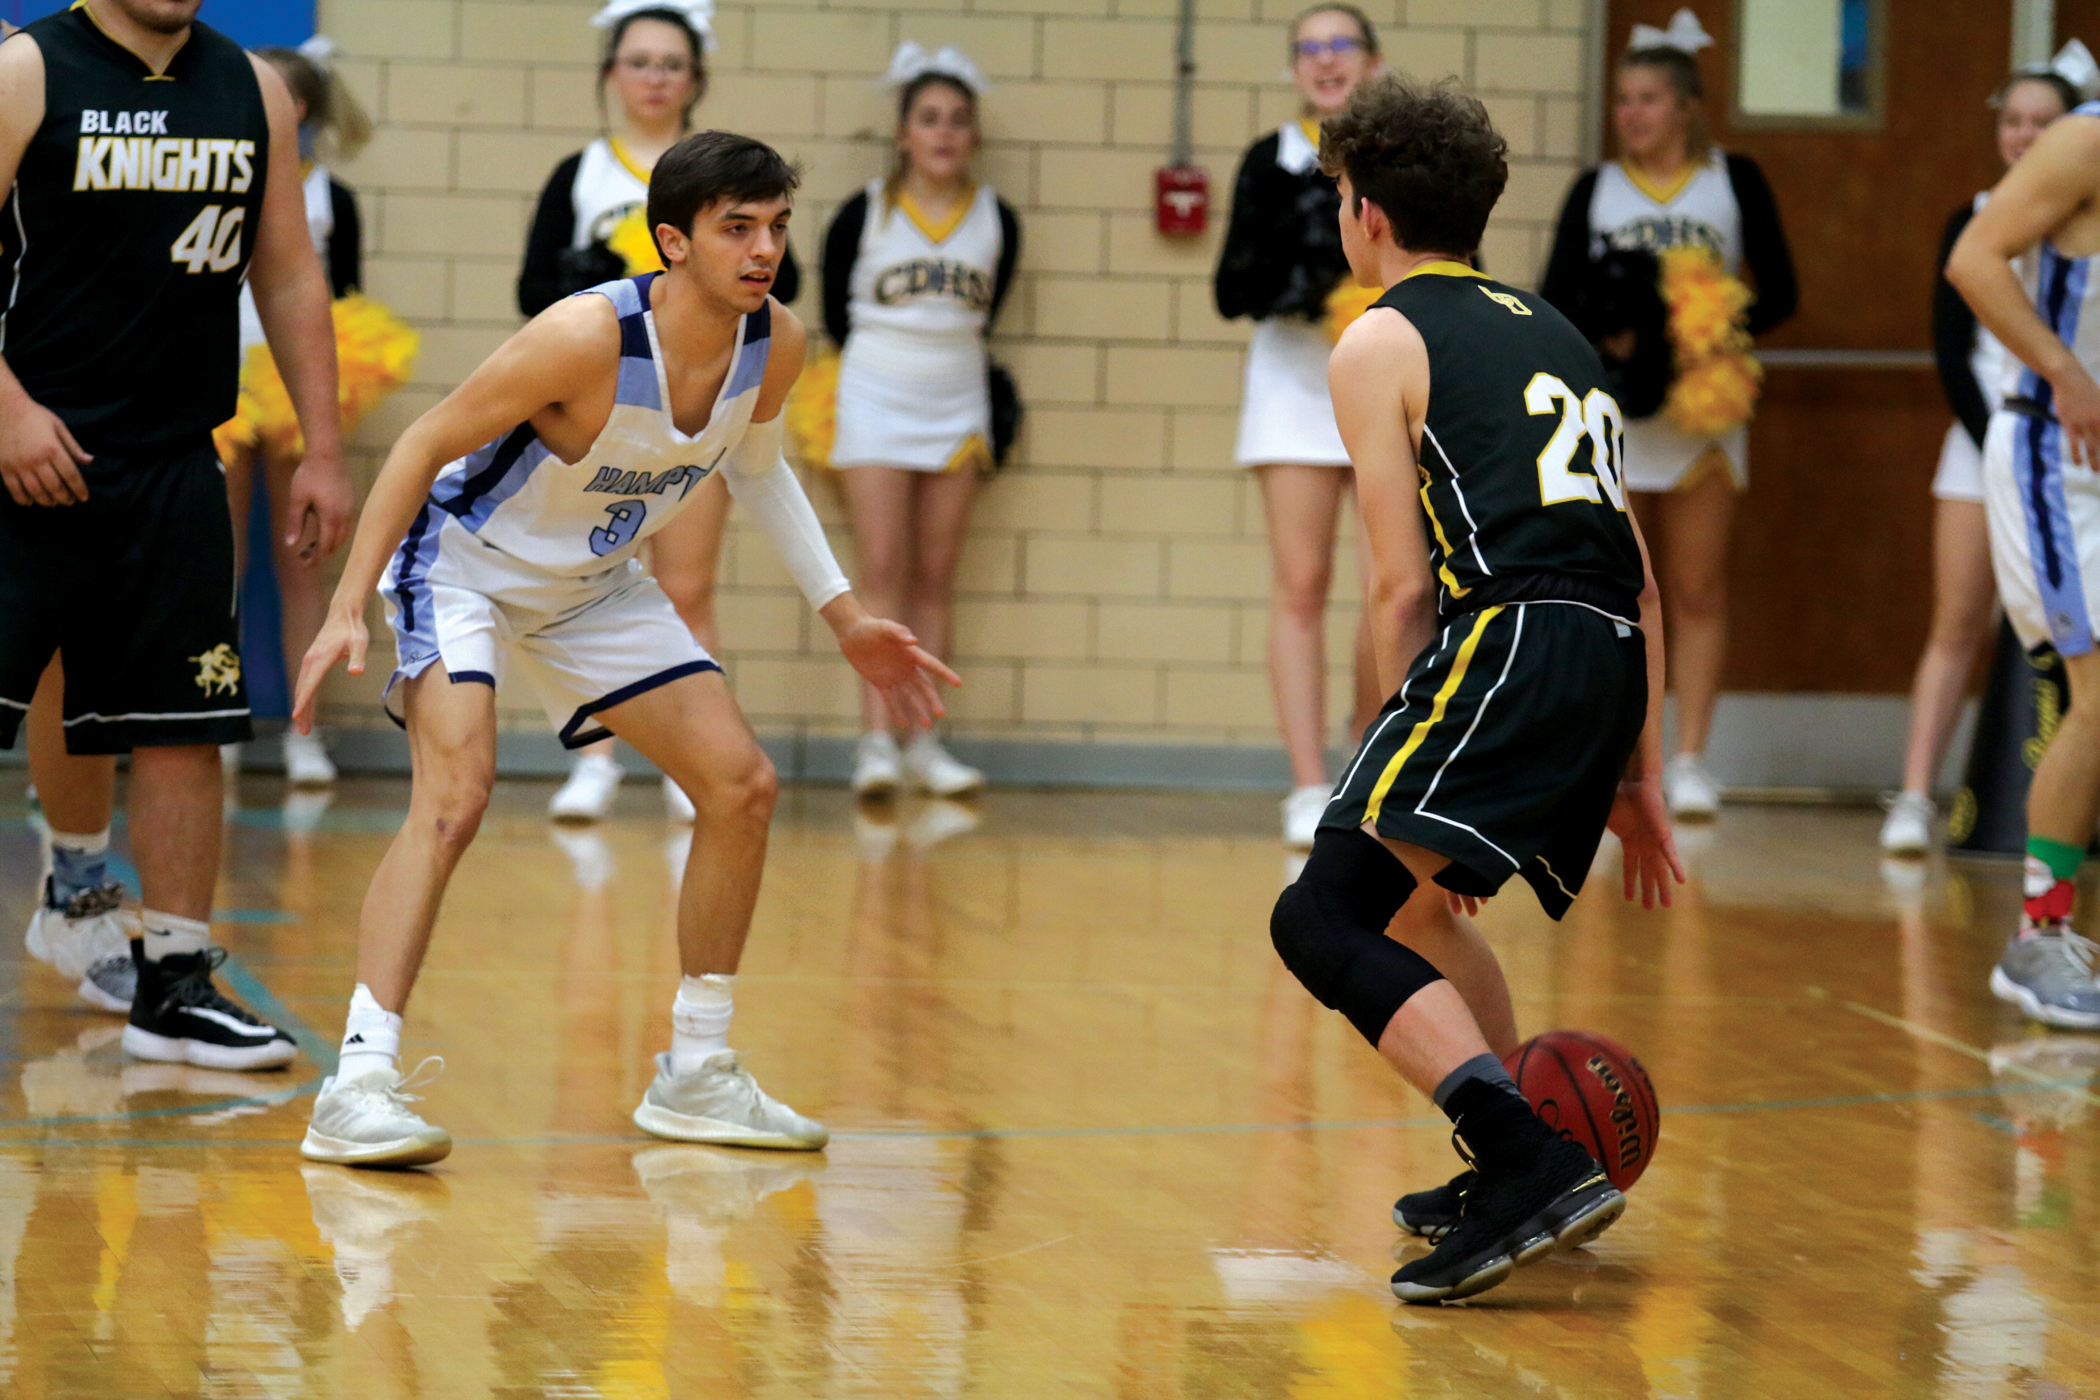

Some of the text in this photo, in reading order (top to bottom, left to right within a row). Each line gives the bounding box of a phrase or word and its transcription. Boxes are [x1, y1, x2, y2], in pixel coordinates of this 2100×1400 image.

[80, 109, 169, 134] BLACK
[72, 136, 255, 193] KNIGHTS
[170, 204, 246, 274] 40
[1523, 371, 1626, 512] 20
[583, 447, 727, 502] HAMPT
[588, 498, 647, 557] 3
[1586, 1055, 1642, 1172] Wilson
